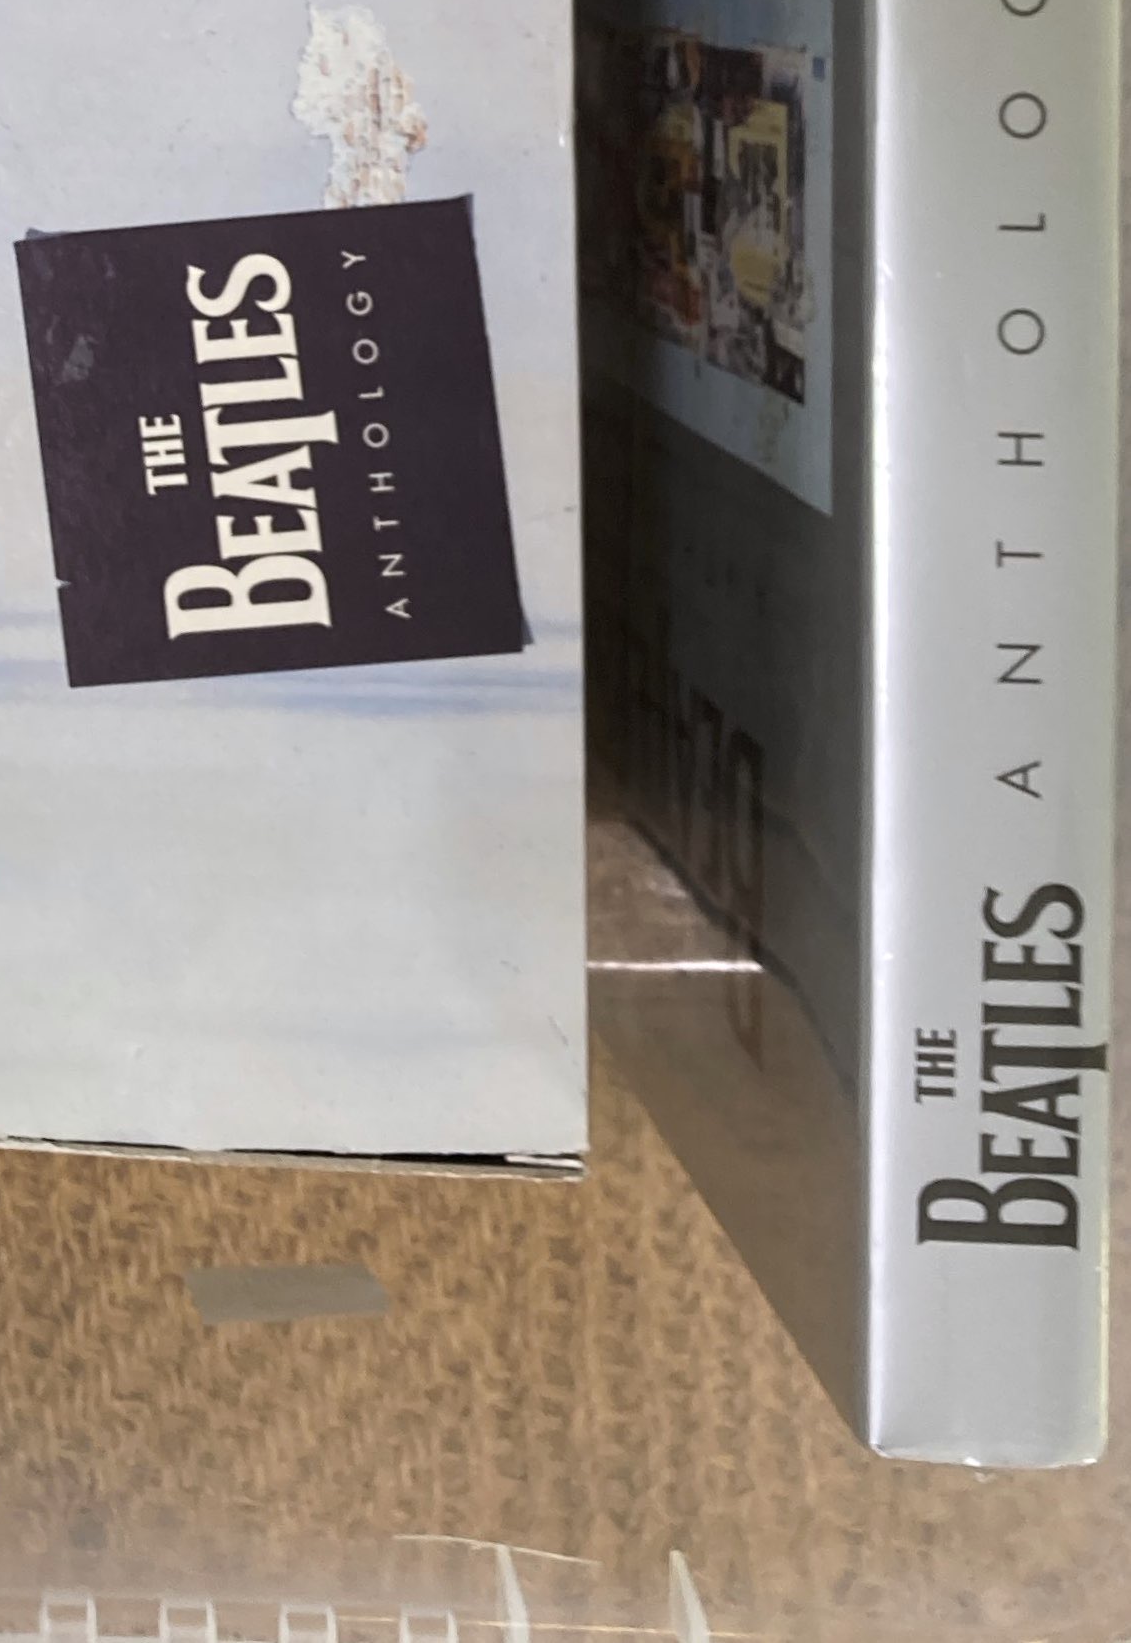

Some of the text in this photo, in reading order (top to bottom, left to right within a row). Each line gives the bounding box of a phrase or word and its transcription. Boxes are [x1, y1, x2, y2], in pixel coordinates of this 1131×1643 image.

[139, 413, 189, 495] THE
[163, 253, 339, 640] BEATLES
[340, 247, 412, 620] ANTHOLOGY
[915, 1027, 956, 1104] THE
[916, 881, 1107, 1250] BEATLES
